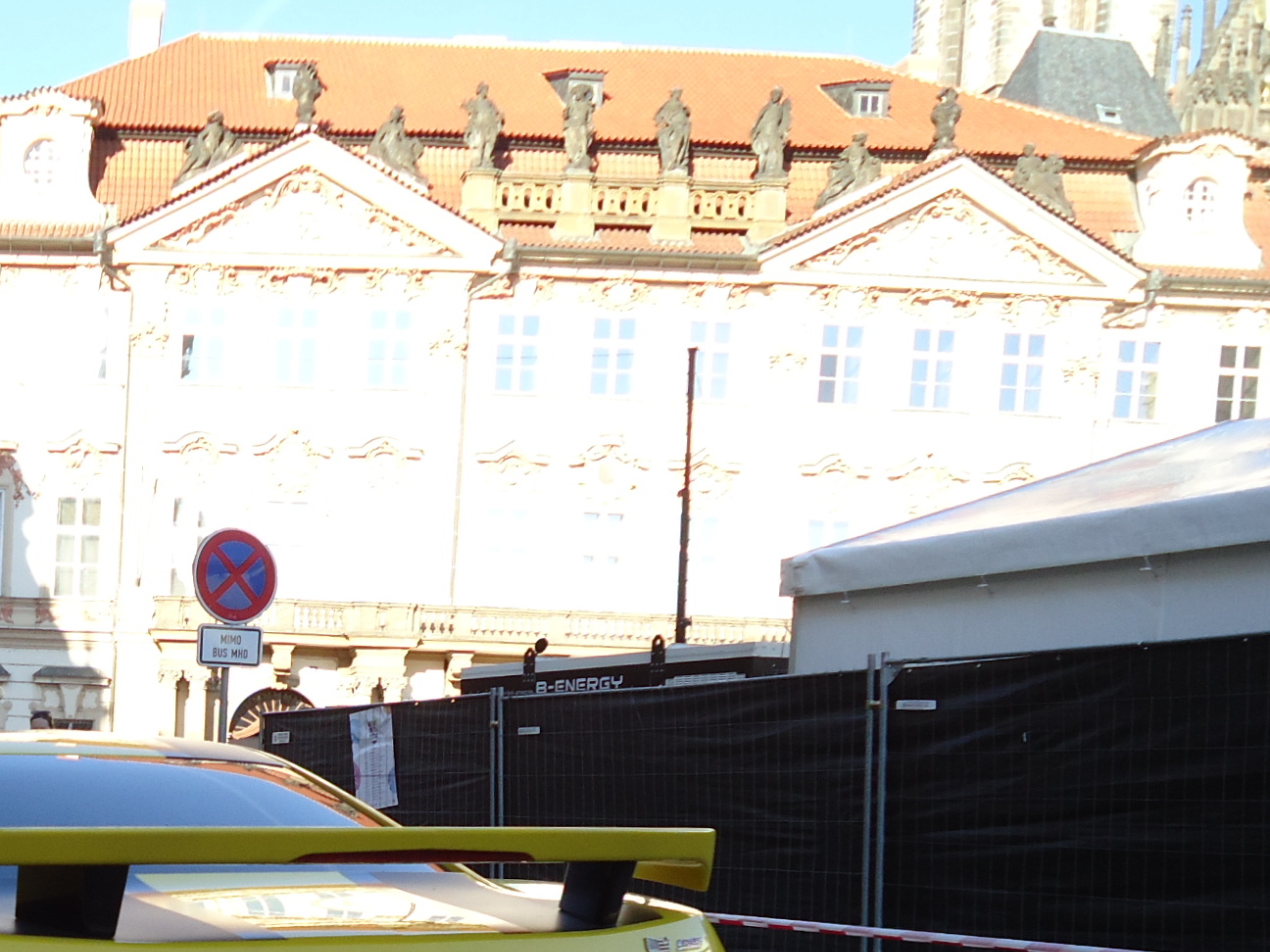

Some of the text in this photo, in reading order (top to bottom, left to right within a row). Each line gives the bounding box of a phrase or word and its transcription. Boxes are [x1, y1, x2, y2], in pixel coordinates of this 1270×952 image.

[220, 634, 242, 645] MIMO
[212, 647, 249, 659] BUS MHD
[535, 675, 624, 694] B-ENERGY
